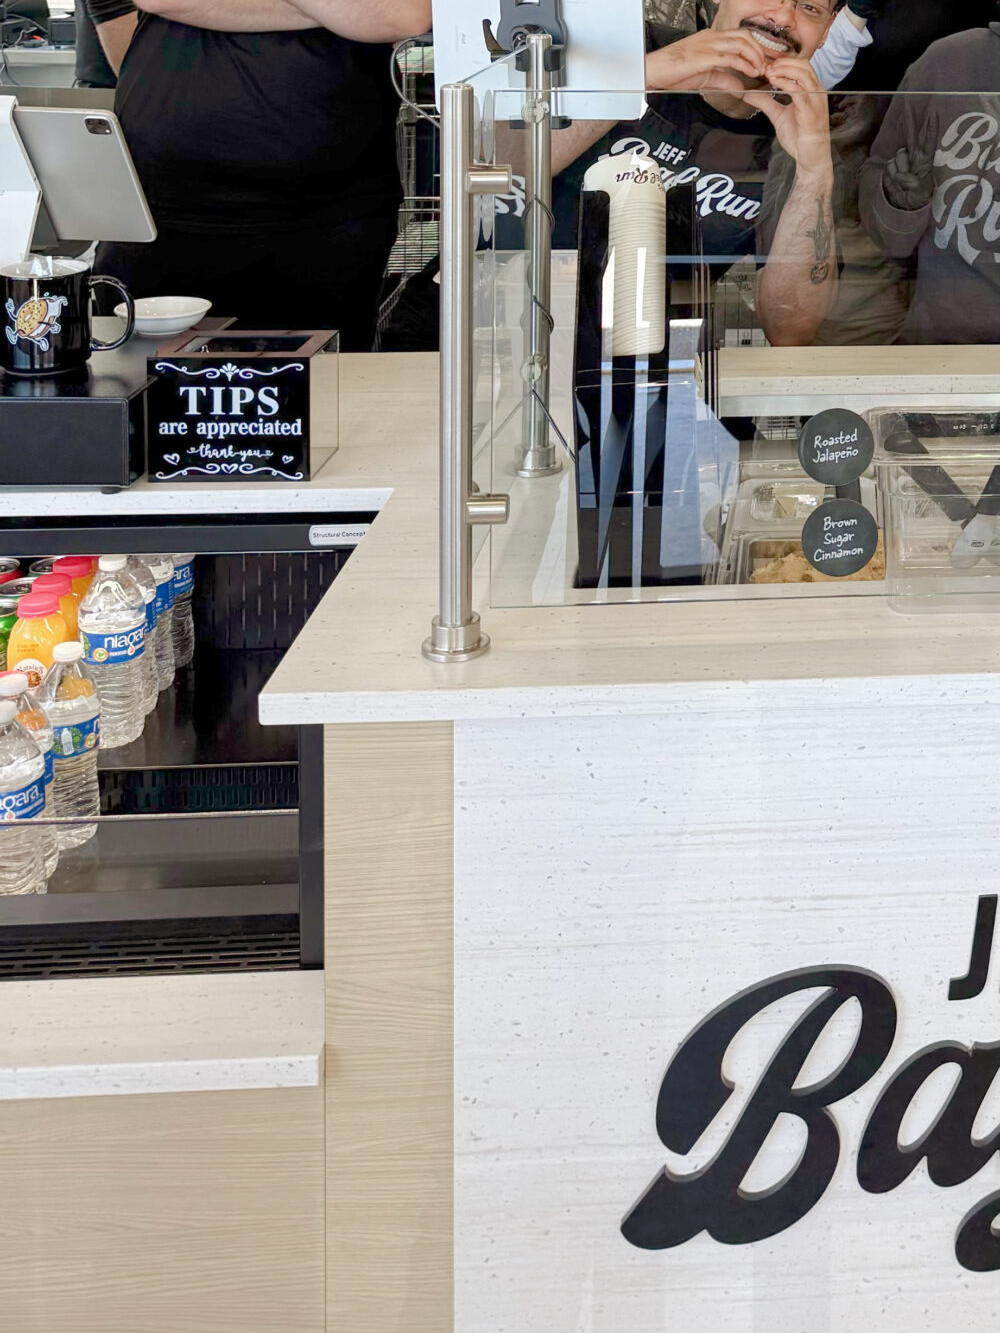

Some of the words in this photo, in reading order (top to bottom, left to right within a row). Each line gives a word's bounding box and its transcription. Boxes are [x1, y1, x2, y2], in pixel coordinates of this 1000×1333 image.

[696, 173, 760, 220] Run
[180, 387, 279, 416] TIPS
[159, 421, 187, 436] are
[197, 419, 302, 439] appreciated
[814, 428, 857, 449] Roasted
[199, 444, 238, 459] thank
[240, 448, 264, 461] you
[812, 446, 859, 464] Jalapeño
[824, 517, 857, 531] Brown
[824, 531, 854, 546] Sugar
[814, 547, 863, 562] Cinnamon
[104, 624, 148, 651] niagar
